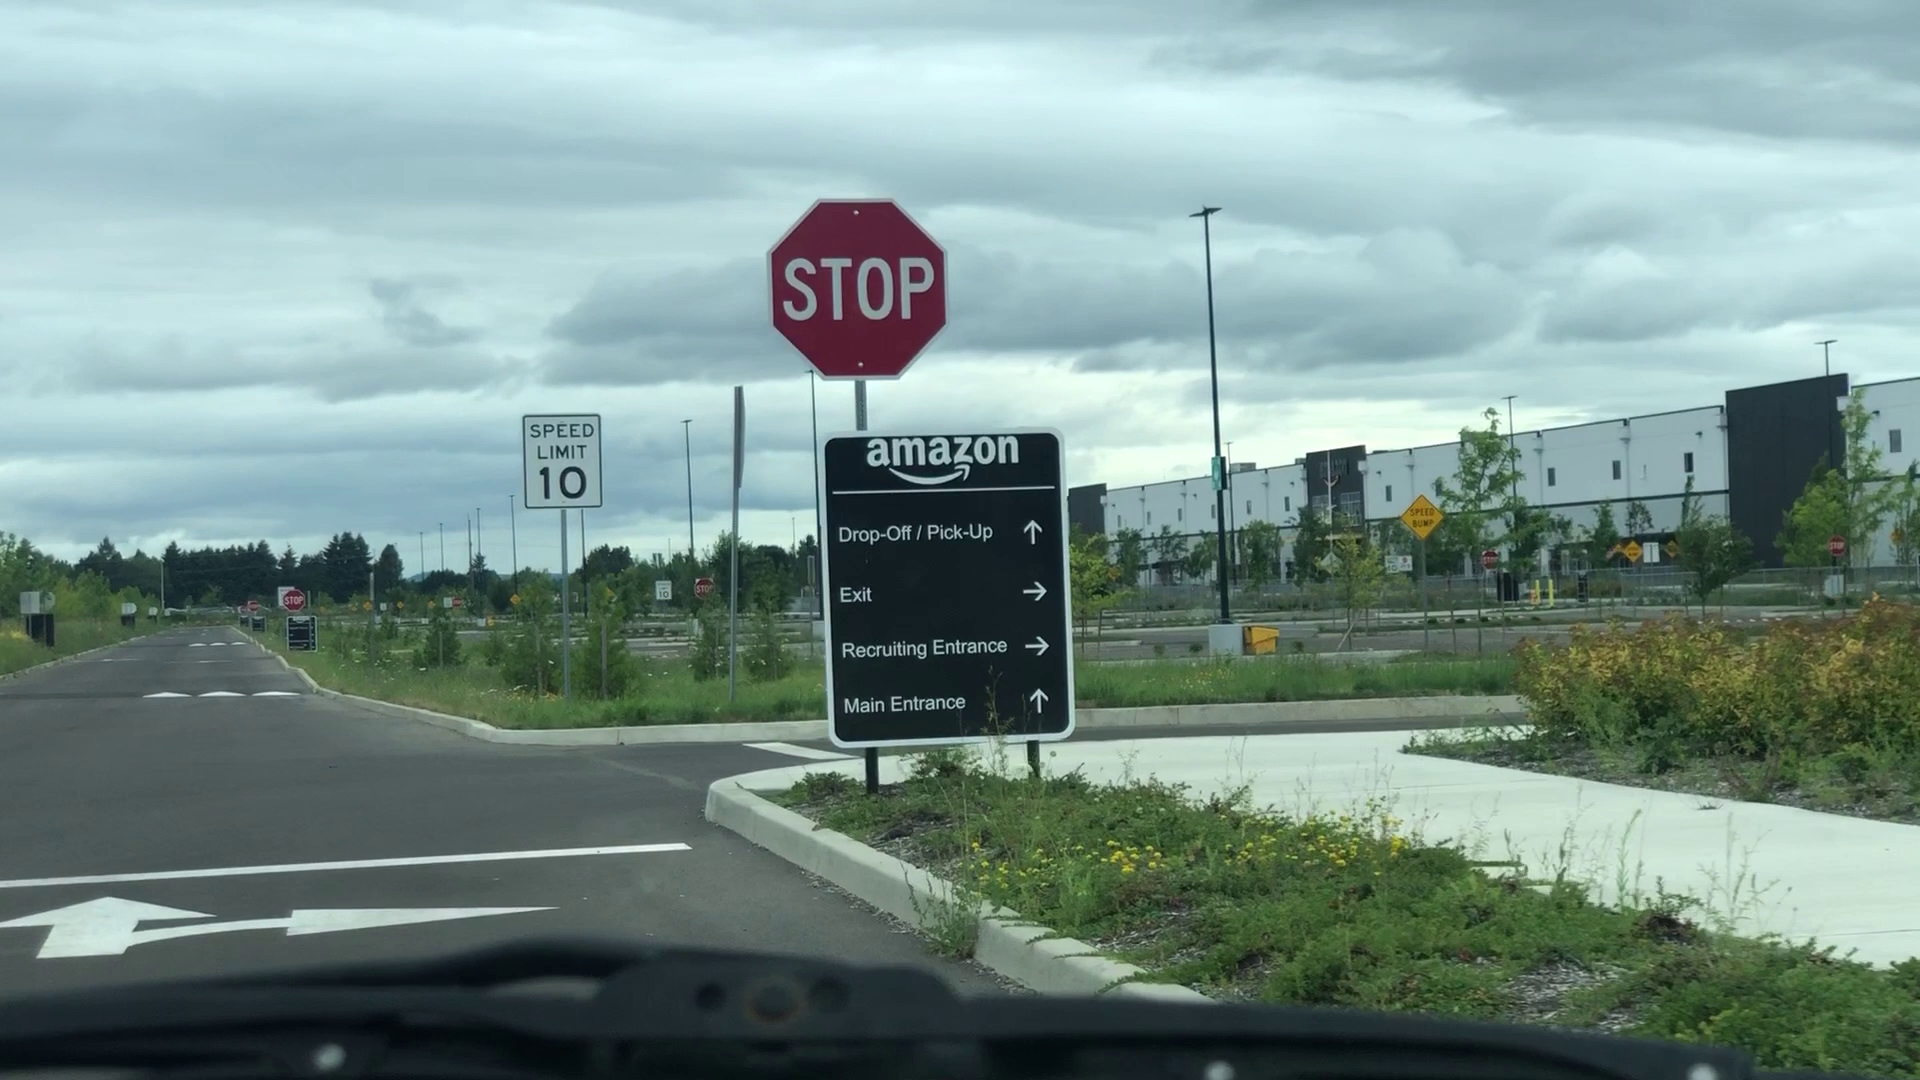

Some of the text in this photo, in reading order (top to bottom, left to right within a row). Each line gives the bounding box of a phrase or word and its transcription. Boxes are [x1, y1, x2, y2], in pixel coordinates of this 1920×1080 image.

[783, 257, 935, 321] STOP
[530, 424, 595, 438] SPEED
[537, 445, 587, 459] LIMIT
[866, 435, 1019, 467] amazon
[540, 466, 587, 500] 10
[1410, 508, 1436, 516] SPEED
[1412, 519, 1435, 528] BUMP
[838, 523, 993, 545] Drop-Off / Pick-Up
[284, 596, 304, 605] STOP
[660, 590, 669, 598] 10
[840, 587, 872, 602] Exit
[842, 639, 1008, 659] Recruiting Entrance
[844, 695, 966, 713] Main Entrance
